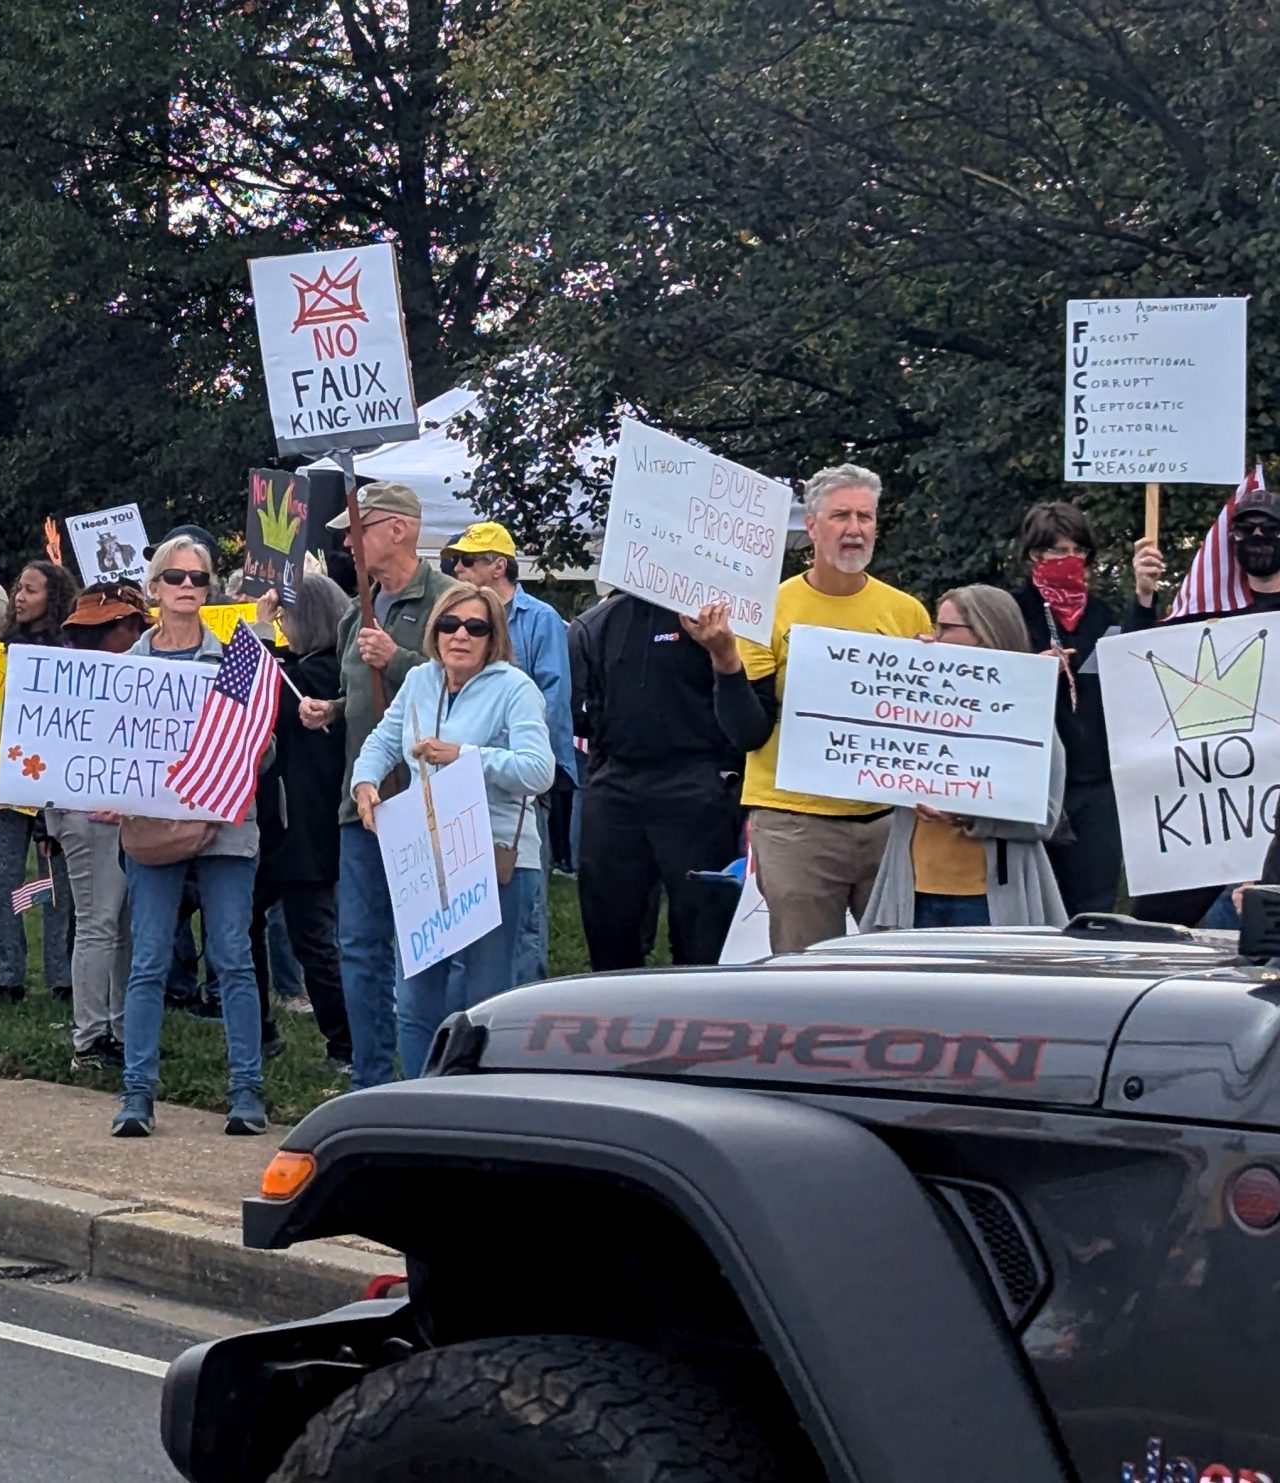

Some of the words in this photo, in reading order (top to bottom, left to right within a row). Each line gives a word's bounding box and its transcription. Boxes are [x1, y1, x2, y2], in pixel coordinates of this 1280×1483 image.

[312, 323, 358, 362] NO
[291, 361, 387, 408] FAUX
[290, 405, 351, 436] KING
[356, 396, 402, 424] WAY
[633, 446, 696, 475] WITHOUT
[710, 463, 767, 517] DUE
[74, 523, 79, 531] I
[81, 518, 108, 530] Need
[110, 511, 134, 524] YOU
[688, 497, 776, 559] PROCESS
[624, 510, 641, 529] IT'S
[652, 525, 682, 545] JUST
[693, 545, 753, 577] CALLED
[22, 656, 217, 713] IMMIGRANT
[827, 646, 861, 663] WE
[868, 651, 898, 668] NO
[909, 657, 1001, 684] LONGER
[876, 670, 931, 688] HAVE
[942, 679, 956, 691] A
[851, 681, 981, 712] DIFFERENCE
[991, 702, 1014, 713] OF
[875, 700, 972, 728] OPINION
[18, 704, 95, 741] MAKE
[107, 715, 194, 753] AMERI
[829, 731, 860, 748] WE
[871, 737, 929, 756] HAVE
[939, 744, 953, 758] A
[65, 755, 166, 798] GREAT
[825, 748, 959, 776] DIFFERENCE
[970, 765, 990, 778] IN
[1174, 735, 1255, 787] NO
[410, 877, 488, 962] DEMOCRACY
[523, 1014, 1049, 1085] RUBICON
